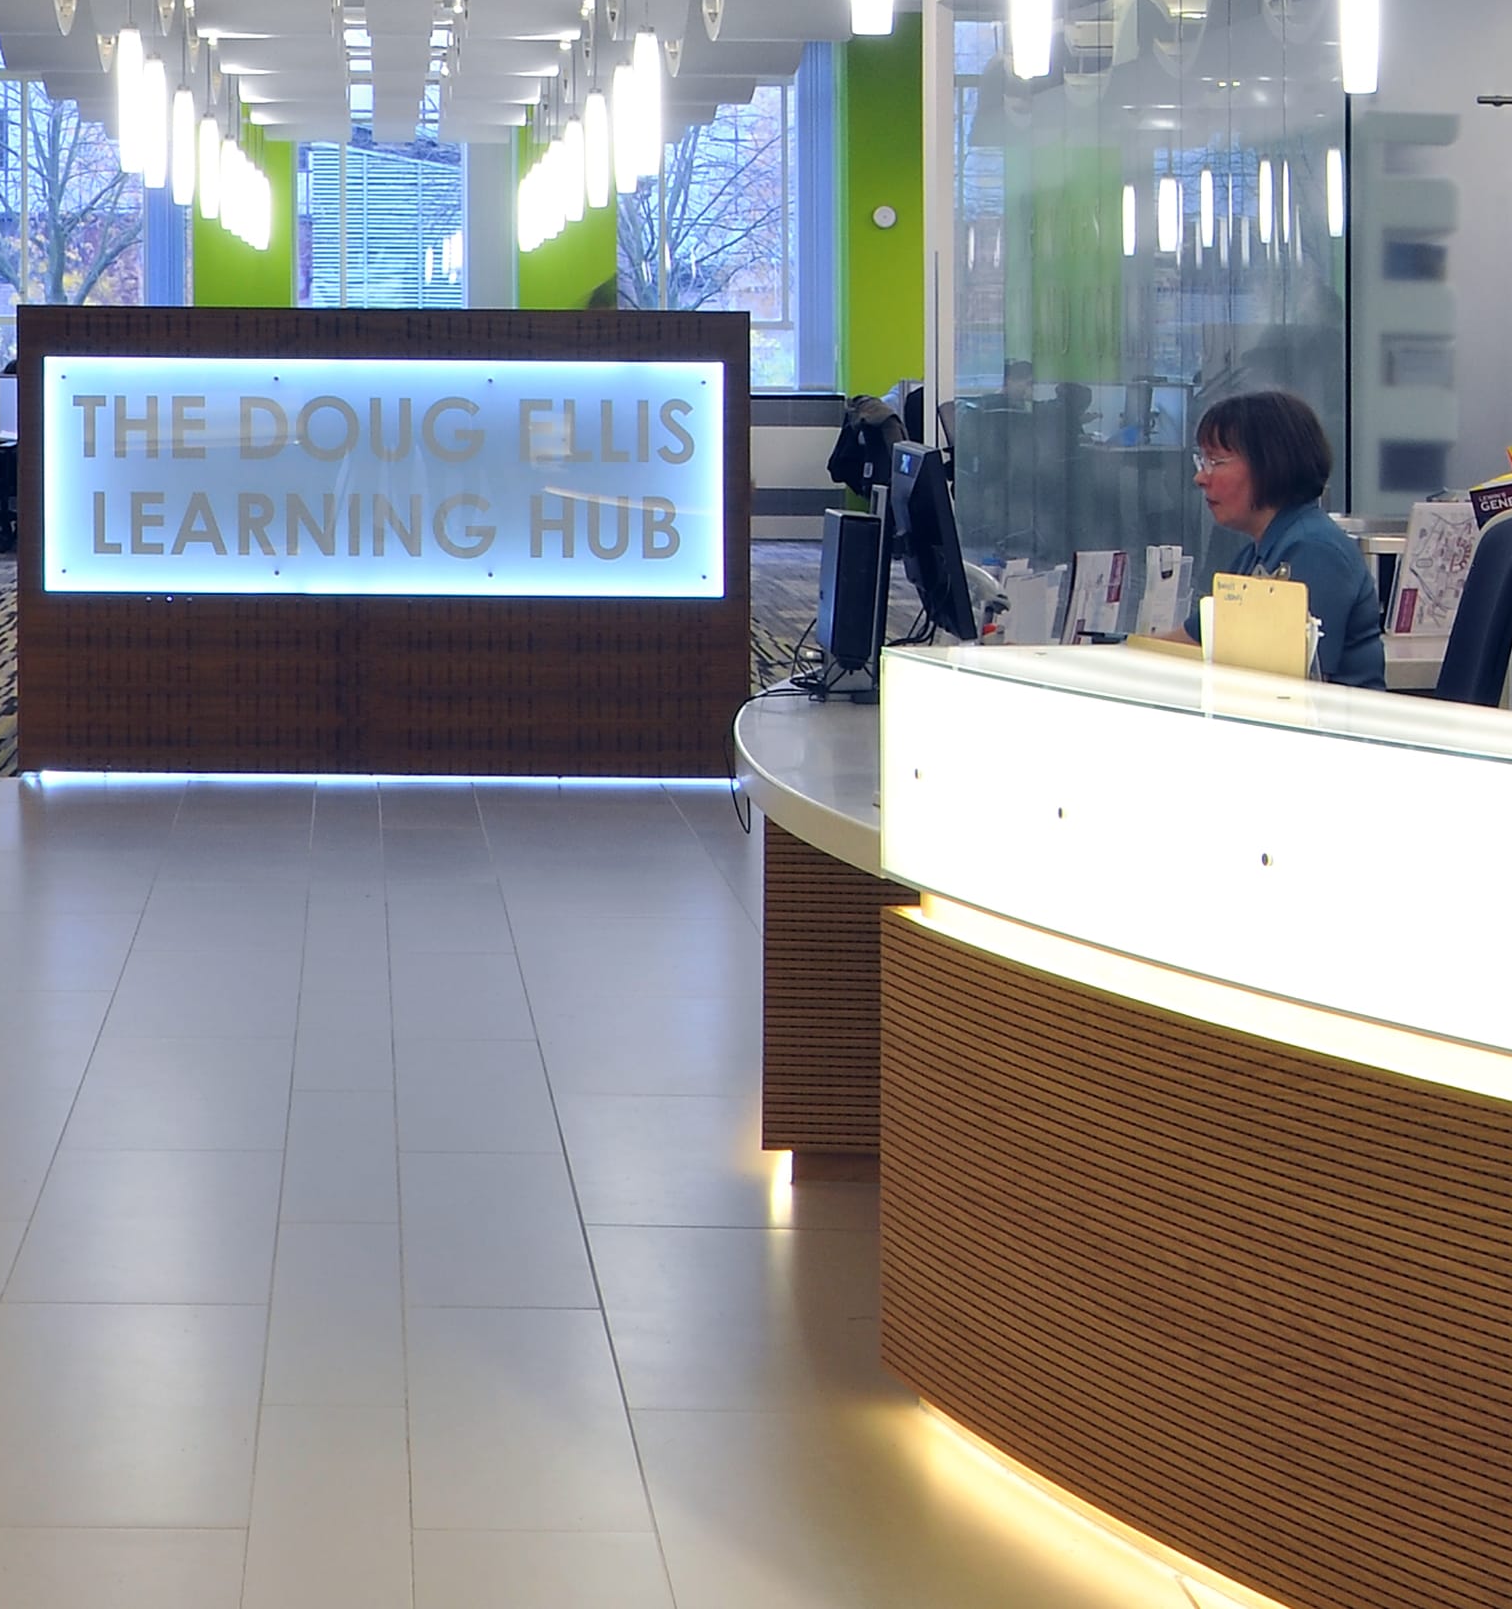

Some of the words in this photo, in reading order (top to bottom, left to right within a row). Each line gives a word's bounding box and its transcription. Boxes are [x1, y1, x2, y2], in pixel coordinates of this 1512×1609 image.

[72, 394, 206, 459] THE
[239, 395, 485, 463] DOUG
[518, 397, 695, 464] ELLIS
[92, 491, 496, 558] LEARNING
[529, 494, 681, 560] HUB
